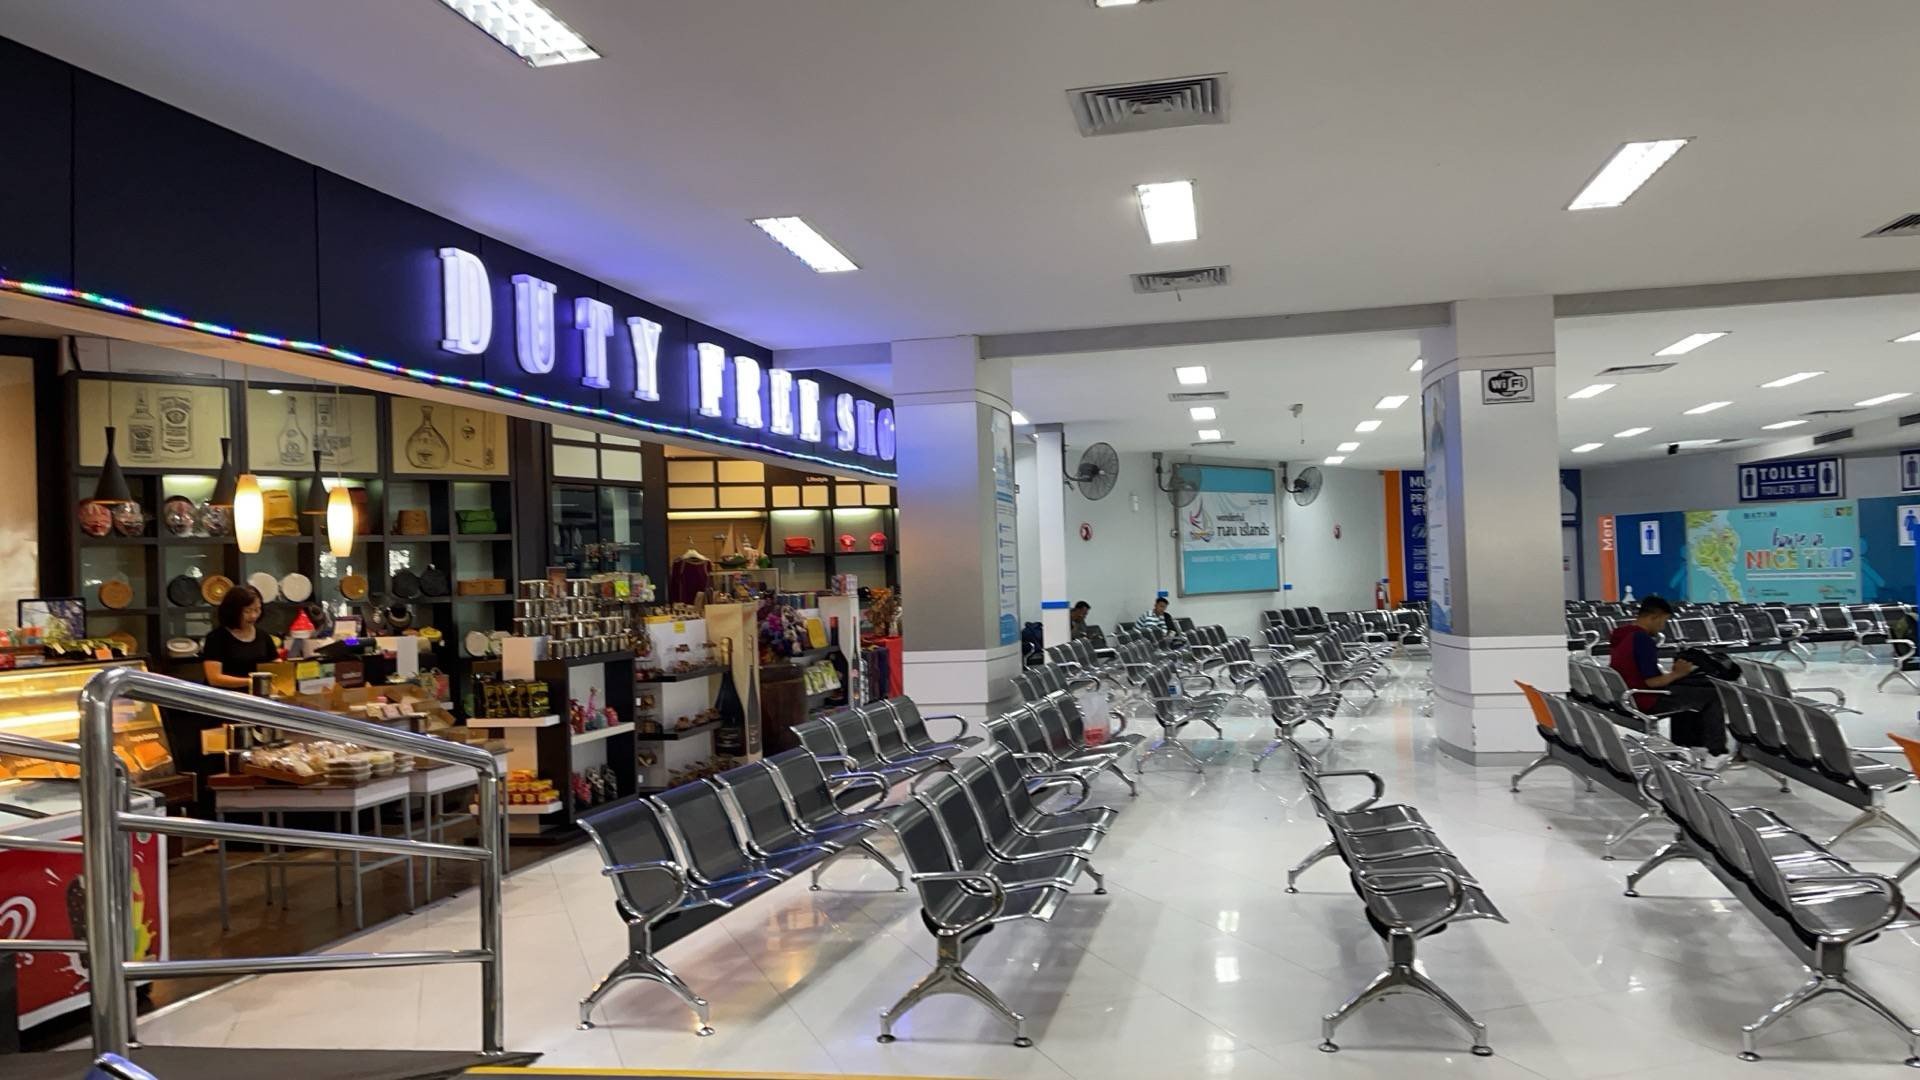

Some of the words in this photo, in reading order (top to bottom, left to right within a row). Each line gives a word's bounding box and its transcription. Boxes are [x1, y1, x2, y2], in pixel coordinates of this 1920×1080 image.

[440, 247, 663, 402] DUTY
[697, 341, 822, 443] FREE
[1759, 464, 1817, 481] TOILET
[1602, 518, 1613, 551] Men
[1745, 548, 1798, 570] NICE
[1802, 547, 1854, 569] TRIP
